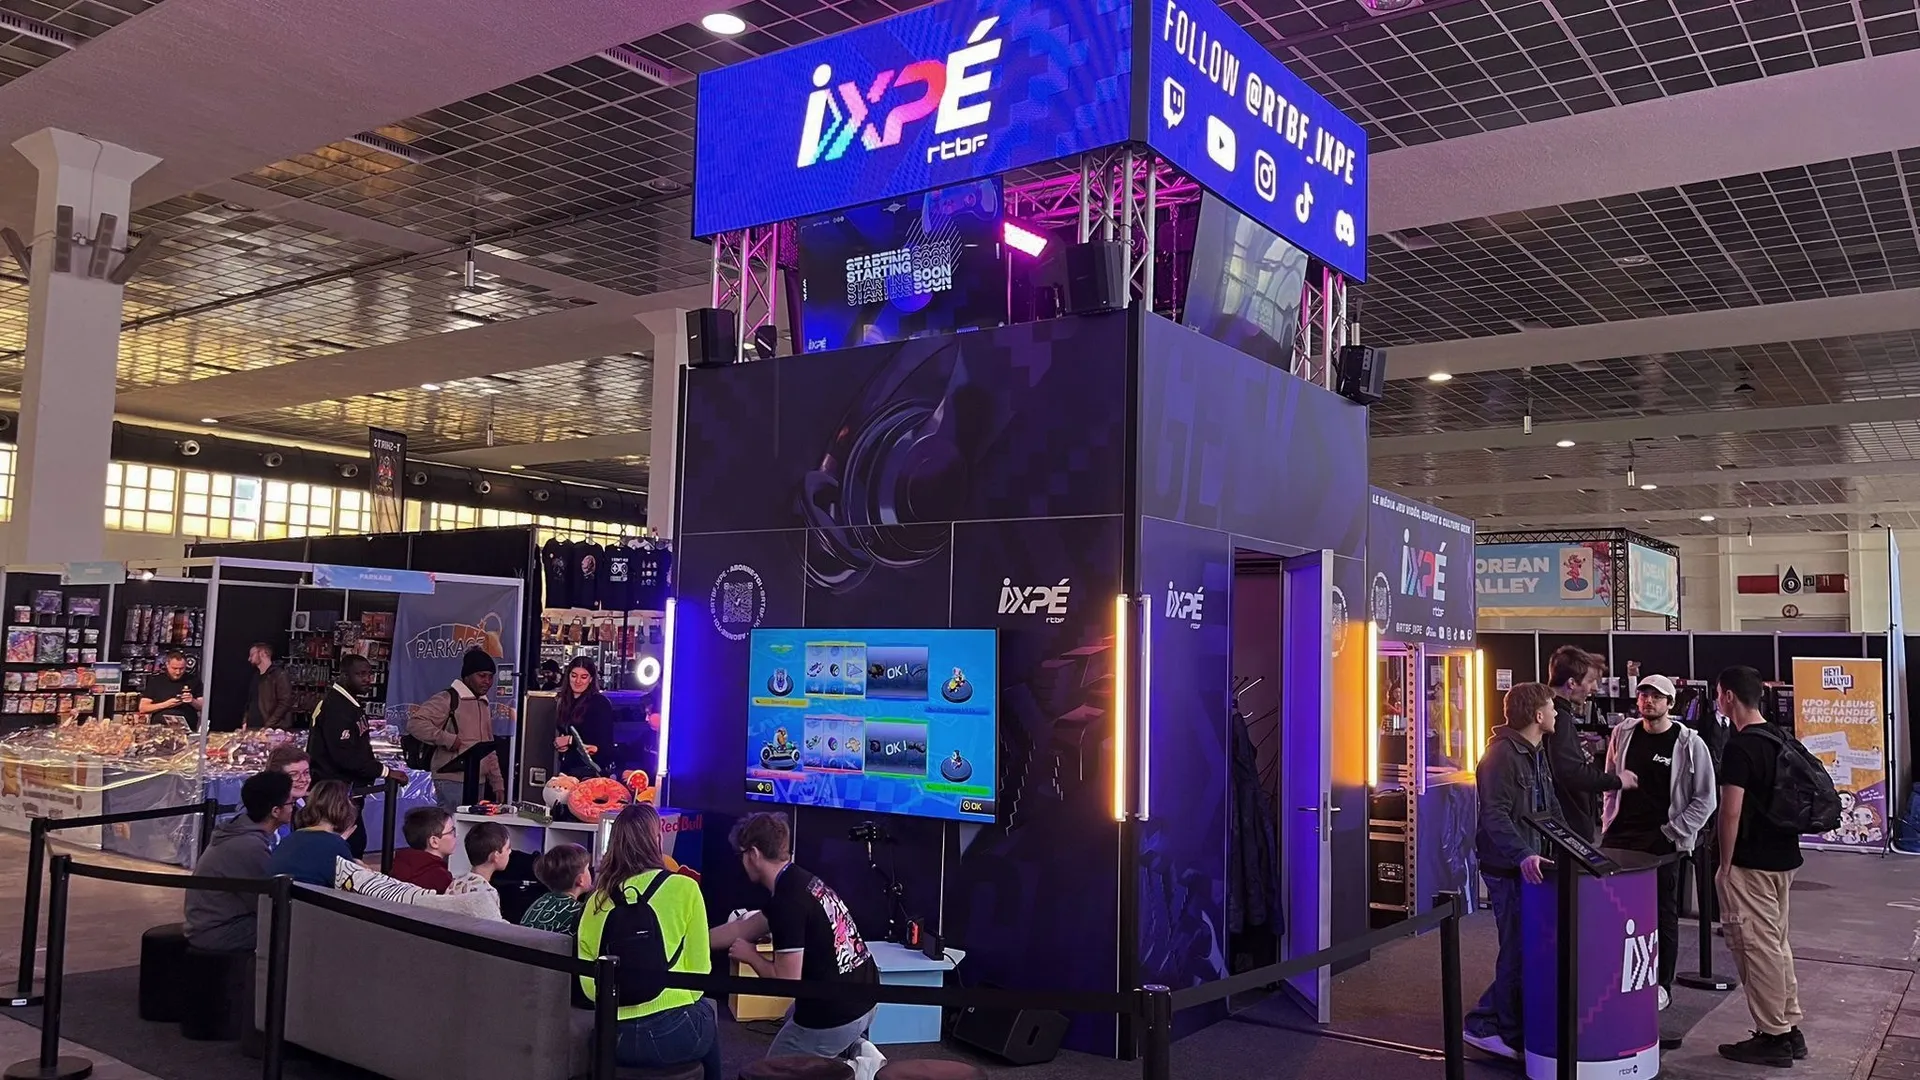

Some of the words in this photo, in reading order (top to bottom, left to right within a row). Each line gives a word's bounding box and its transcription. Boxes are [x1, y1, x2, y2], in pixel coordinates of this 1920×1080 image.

[1164, 0, 1240, 97] FOLLOW
[1246, 72, 1355, 185] @RTBF_IXPE
[1475, 556, 1550, 574] OREAN
[1802, 699, 1831, 707] KPOP
[1832, 700, 1875, 708] ALBUMS
